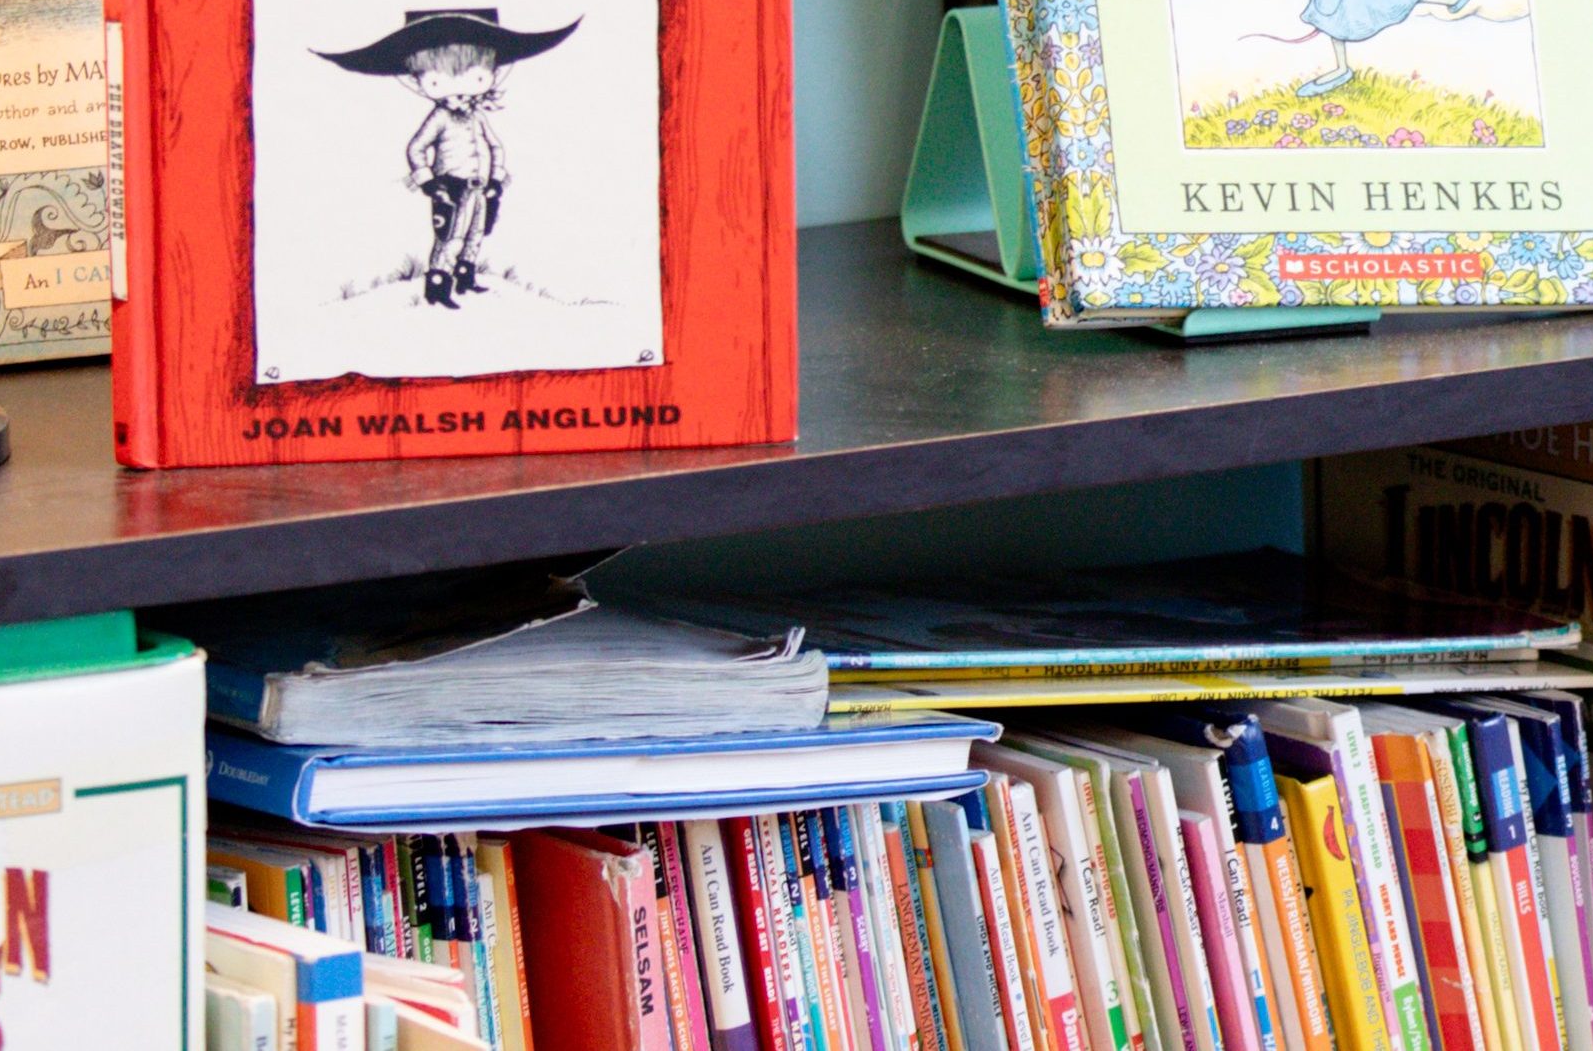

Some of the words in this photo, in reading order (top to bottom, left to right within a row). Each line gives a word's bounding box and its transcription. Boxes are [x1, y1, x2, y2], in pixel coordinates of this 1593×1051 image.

[37, 62, 58, 86] by
[47, 100, 78, 117] and
[42, 131, 108, 148] PUBLISHE
[1180, 182, 1336, 212] KEVIN
[1363, 180, 1564, 211] HENKES
[24, 273, 49, 291] An
[1309, 257, 1476, 275] SCHOLASTIC
[242, 415, 342, 441] JOAN
[357, 410, 485, 436] WALSH
[499, 404, 681, 431] ANGLUND
[1409, 455, 1447, 479] THE
[1453, 465, 1546, 503] ORIGINAL
[1257, 760, 1274, 807] READING
[1271, 817, 1279, 830] 4
[700, 843, 713, 860] An
[706, 874, 721, 909] Can
[1021, 811, 1032, 827] An
[1027, 844, 1041, 876] Can
[1035, 876, 1051, 914] Read
[1044, 915, 1057, 957] Book
[1516, 881, 1531, 913] HILLS
[712, 914, 728, 954] Read
[633, 907, 654, 1016] SELSAM
[720, 957, 735, 994] Book
